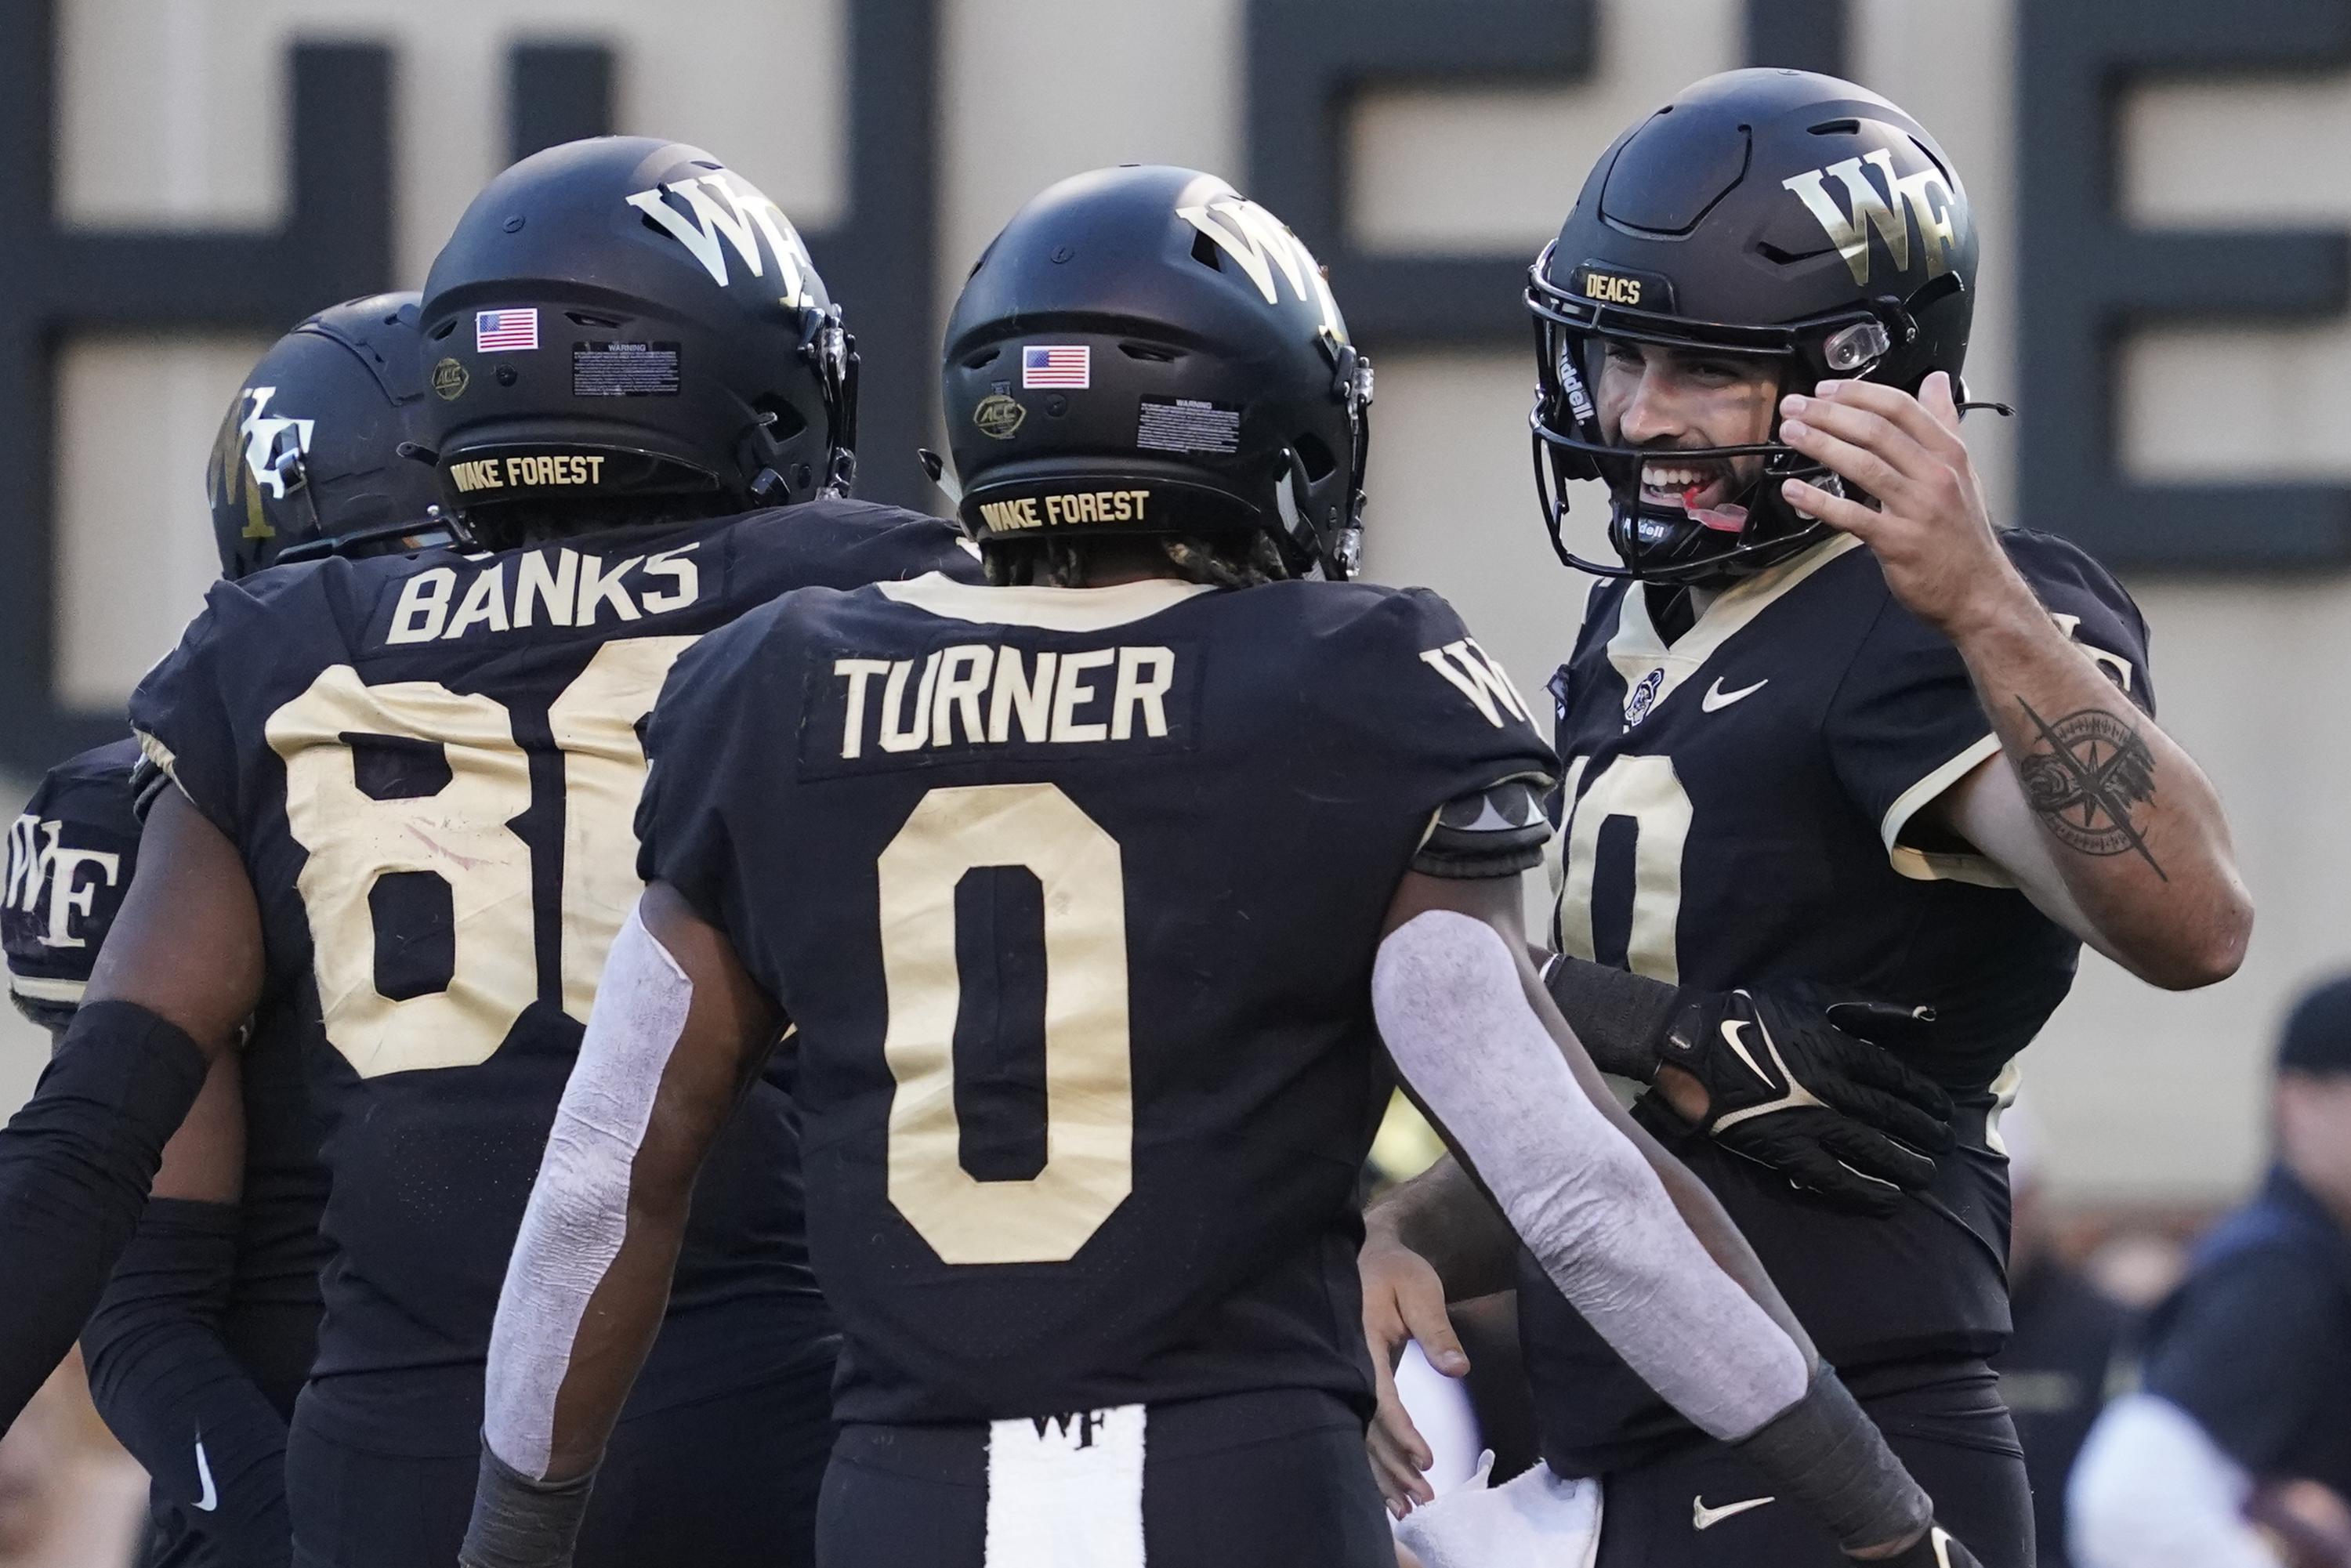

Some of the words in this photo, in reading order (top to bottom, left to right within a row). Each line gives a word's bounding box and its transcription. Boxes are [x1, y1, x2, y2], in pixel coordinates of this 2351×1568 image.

[1781, 147, 1956, 288] WF
[1585, 273, 1642, 305] DEACS
[607, 343, 647, 352] WARNING
[1176, 398, 1213, 411] WARNING
[449, 458, 504, 493] WAKE
[505, 455, 605, 487] FOREST
[980, 498, 1042, 533] WAKE
[1045, 490, 1150, 525] FOREST
[1623, 517, 1665, 539] Rdell
[385, 541, 701, 645] BANKS
[834, 644, 1175, 759] TURNER
[2, 813, 119, 947] WF
[877, 782, 1133, 1265] 0
[1031, 1410, 1105, 1451] WF
